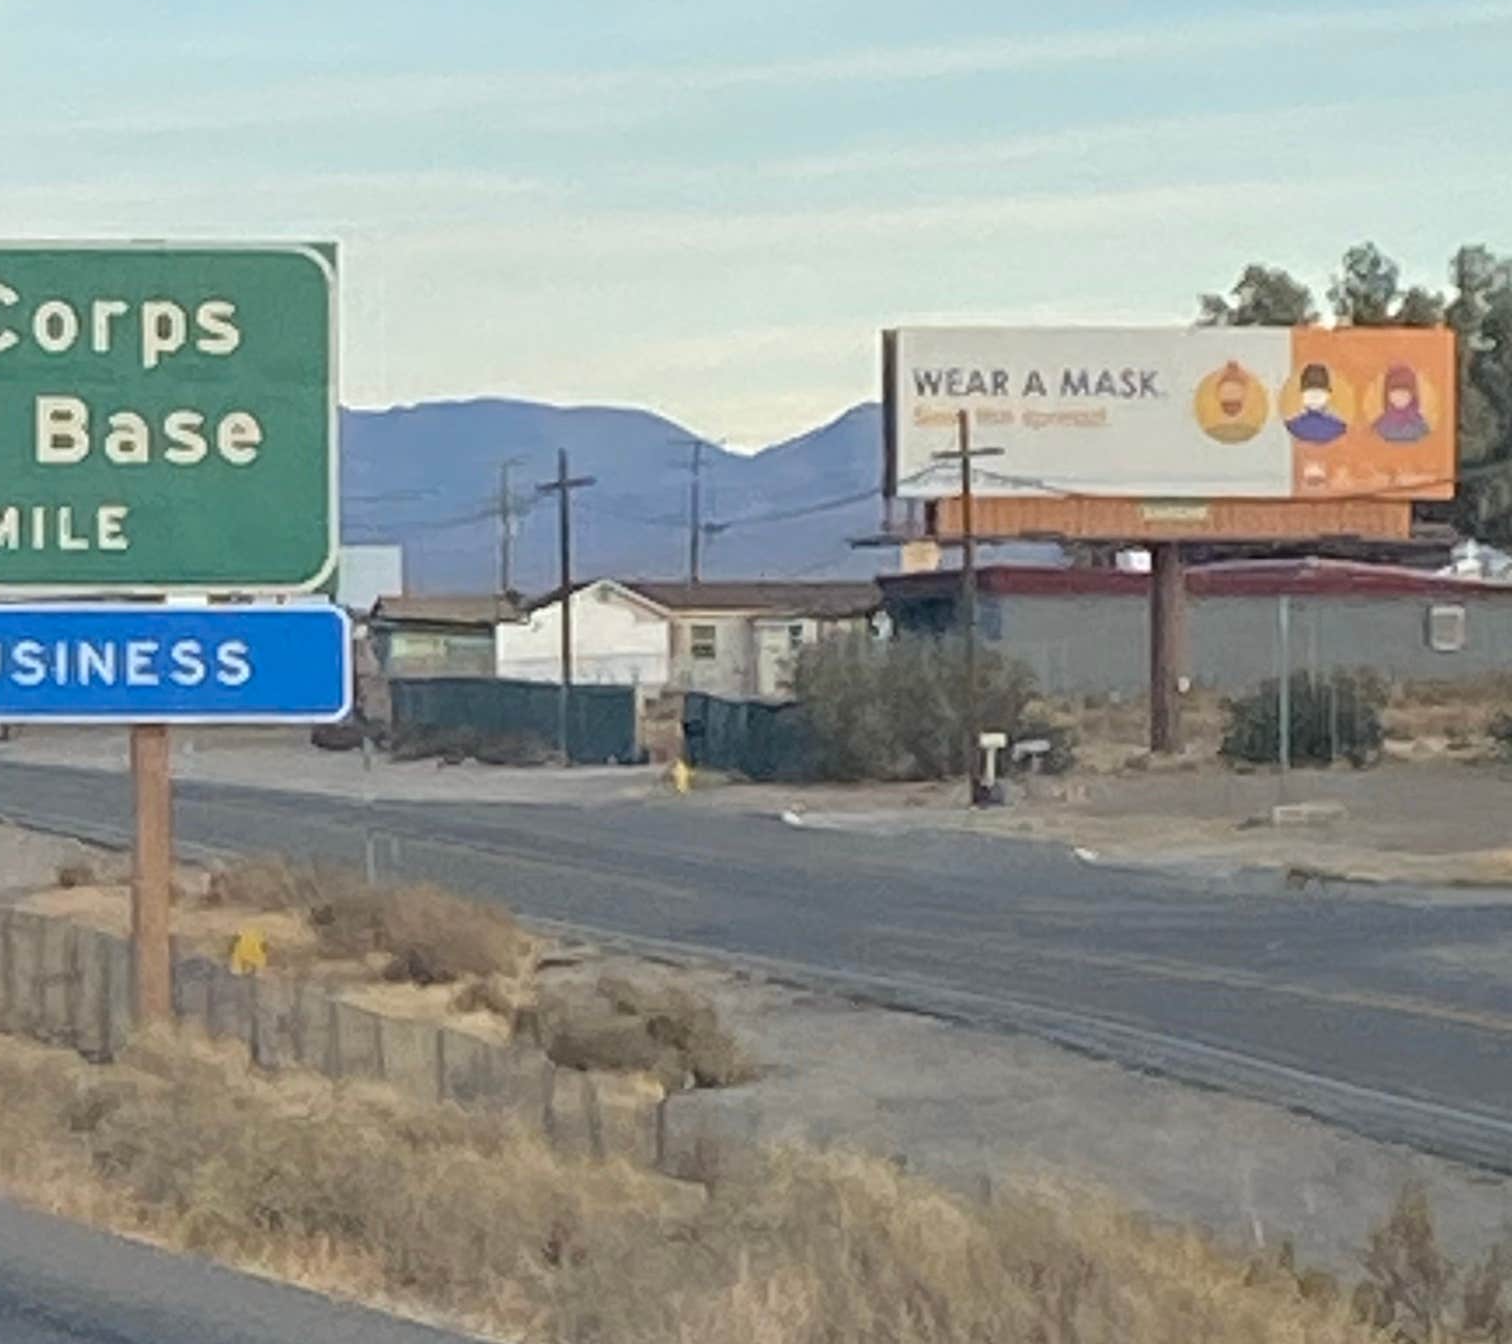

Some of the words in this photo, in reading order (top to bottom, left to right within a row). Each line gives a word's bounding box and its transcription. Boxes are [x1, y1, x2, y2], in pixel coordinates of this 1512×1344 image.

[912, 368, 1009, 397] WEAR
[1022, 370, 1048, 397] A
[35, 395, 263, 465] Base
